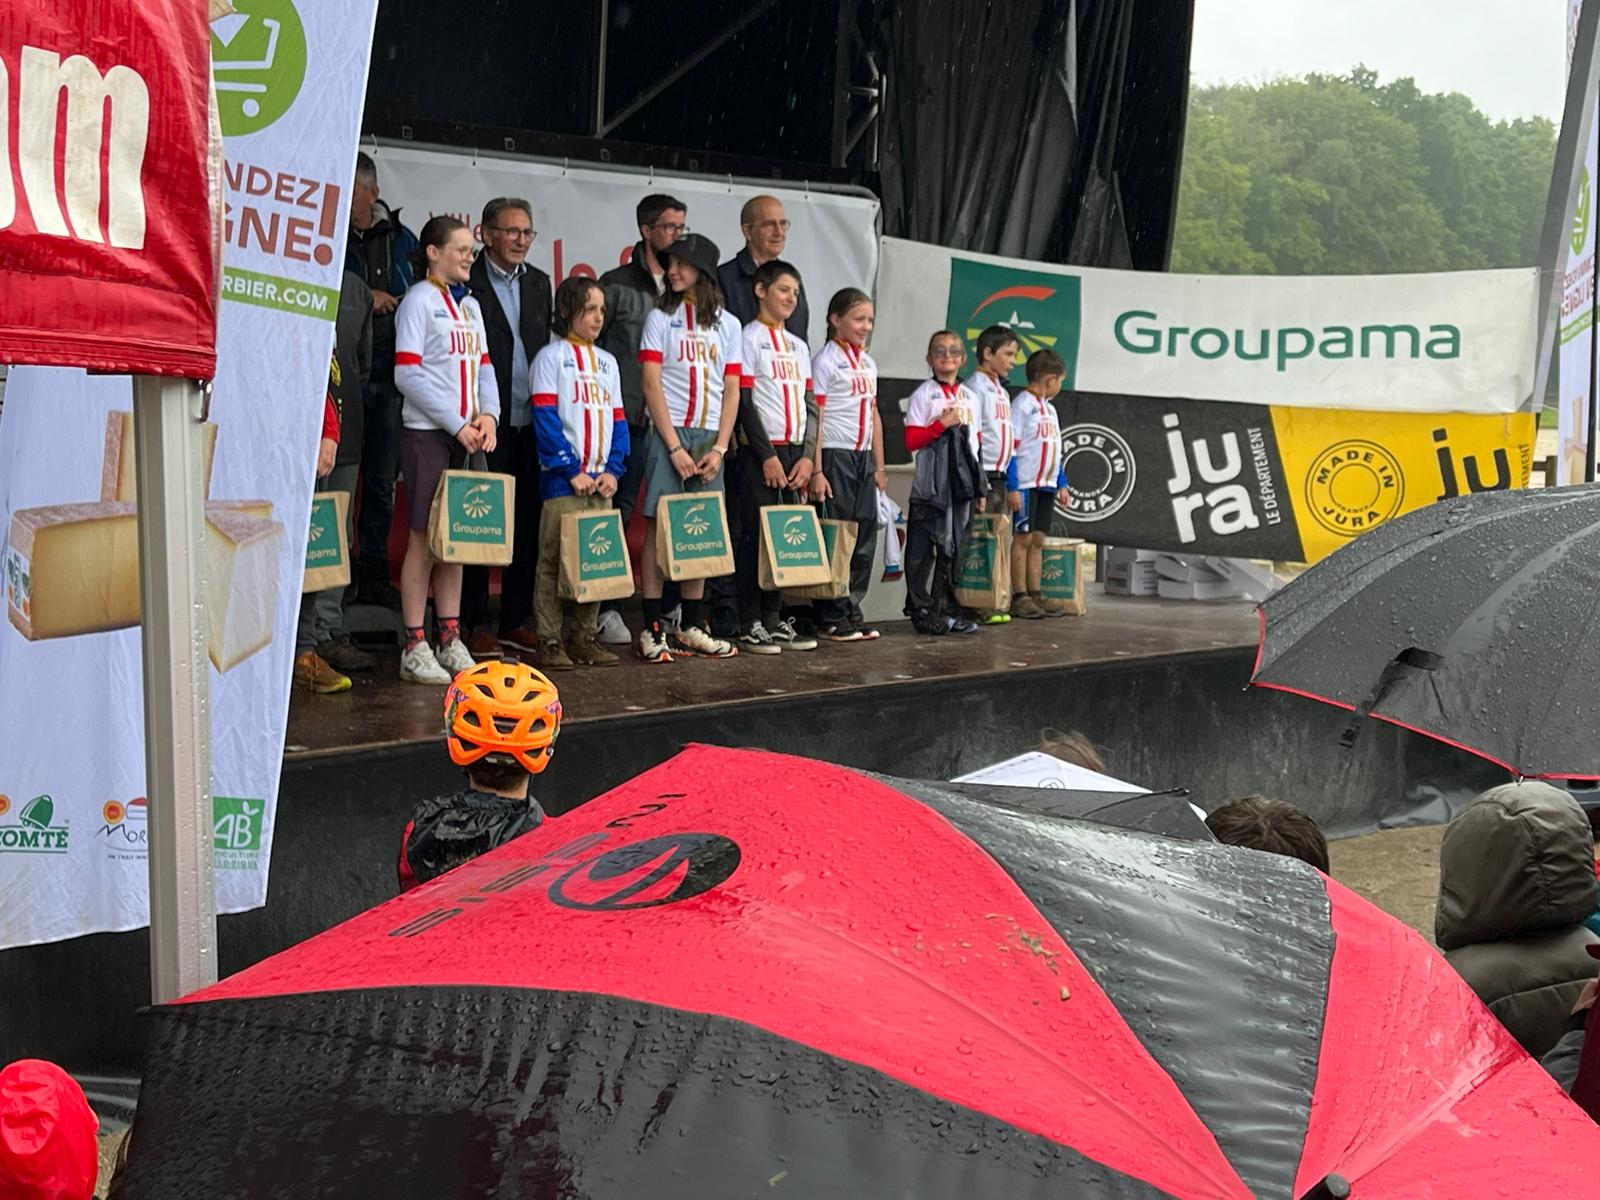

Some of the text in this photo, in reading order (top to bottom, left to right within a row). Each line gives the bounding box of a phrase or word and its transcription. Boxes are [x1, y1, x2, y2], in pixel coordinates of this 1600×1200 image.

[448, 331, 482, 356] JURA
[677, 340, 718, 365] JURA
[1113, 310, 1461, 372] Groupama
[572, 381, 611, 406] JURA
[1063, 434, 1126, 474] ADE IN
[1163, 413, 1242, 494] ju
[1432, 428, 1511, 501] ju
[1247, 427, 1281, 525] LE DÉPARTEMENT
[1316, 450, 1395, 489] MADE IN
[1068, 493, 1113, 512] URA
[1172, 484, 1260, 543] ra
[453, 522, 502, 536] Groupama
[1323, 506, 1380, 527] JURA
[675, 541, 723, 552] Groupama
[778, 551, 819, 561] Groupama
[582, 560, 624, 572] Groupama
[214, 813, 252, 848] AB
